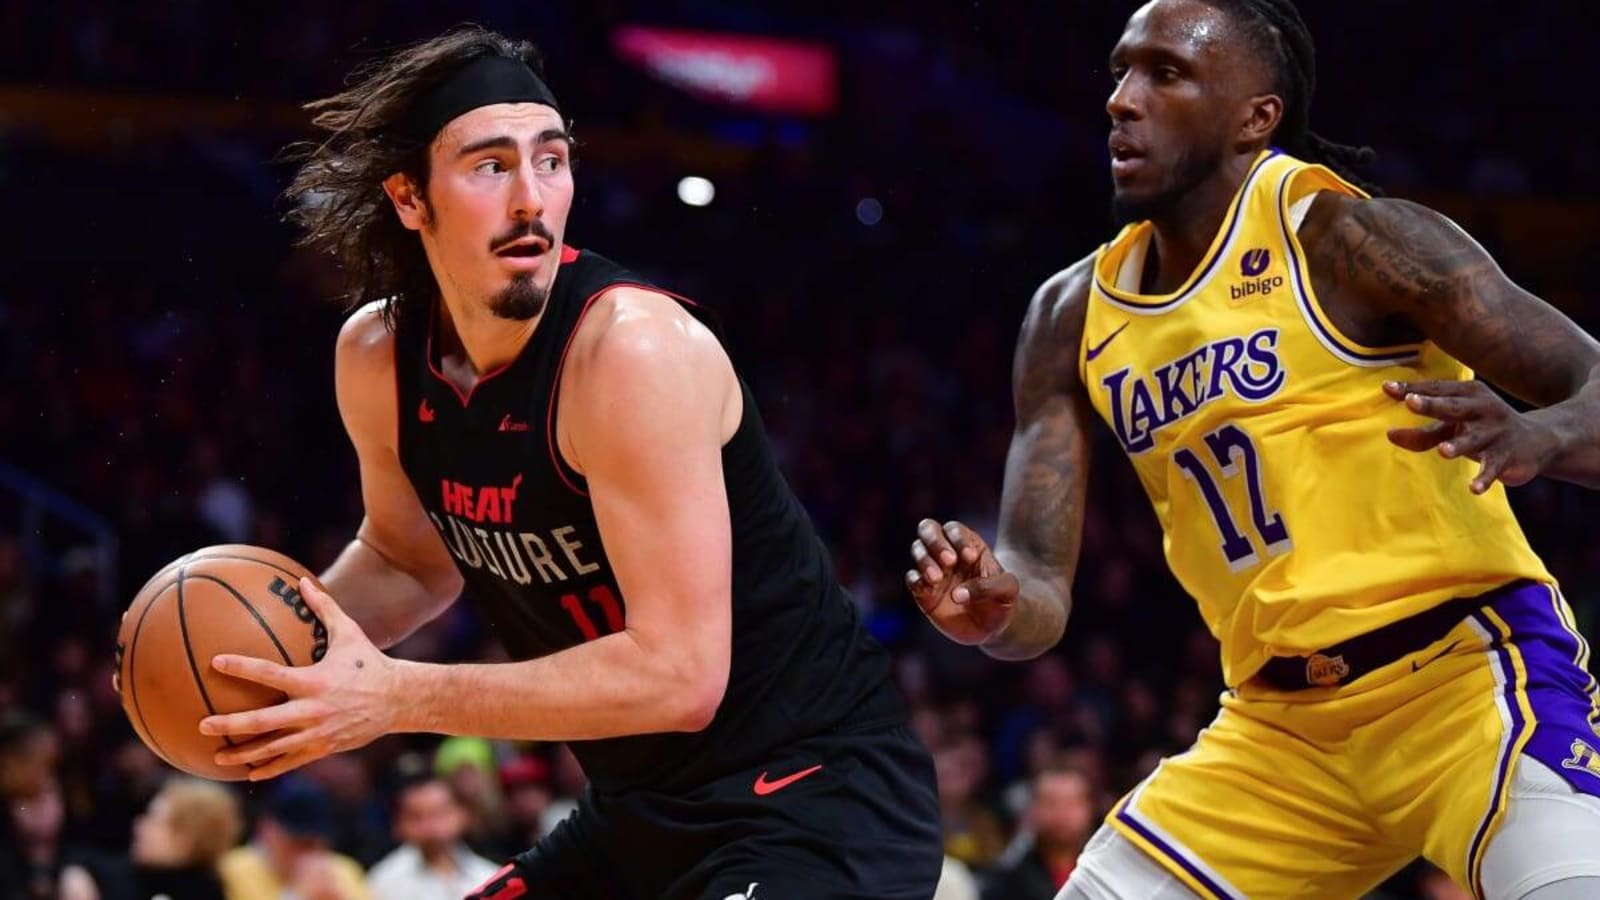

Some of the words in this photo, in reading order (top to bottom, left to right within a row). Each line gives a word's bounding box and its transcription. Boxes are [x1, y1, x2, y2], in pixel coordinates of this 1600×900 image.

[1230, 275, 1283, 300] bibigo
[1102, 329, 1287, 453] LAKERS
[441, 473, 522, 523] HEAT
[1173, 424, 1292, 570] 12
[560, 585, 626, 641] 11
